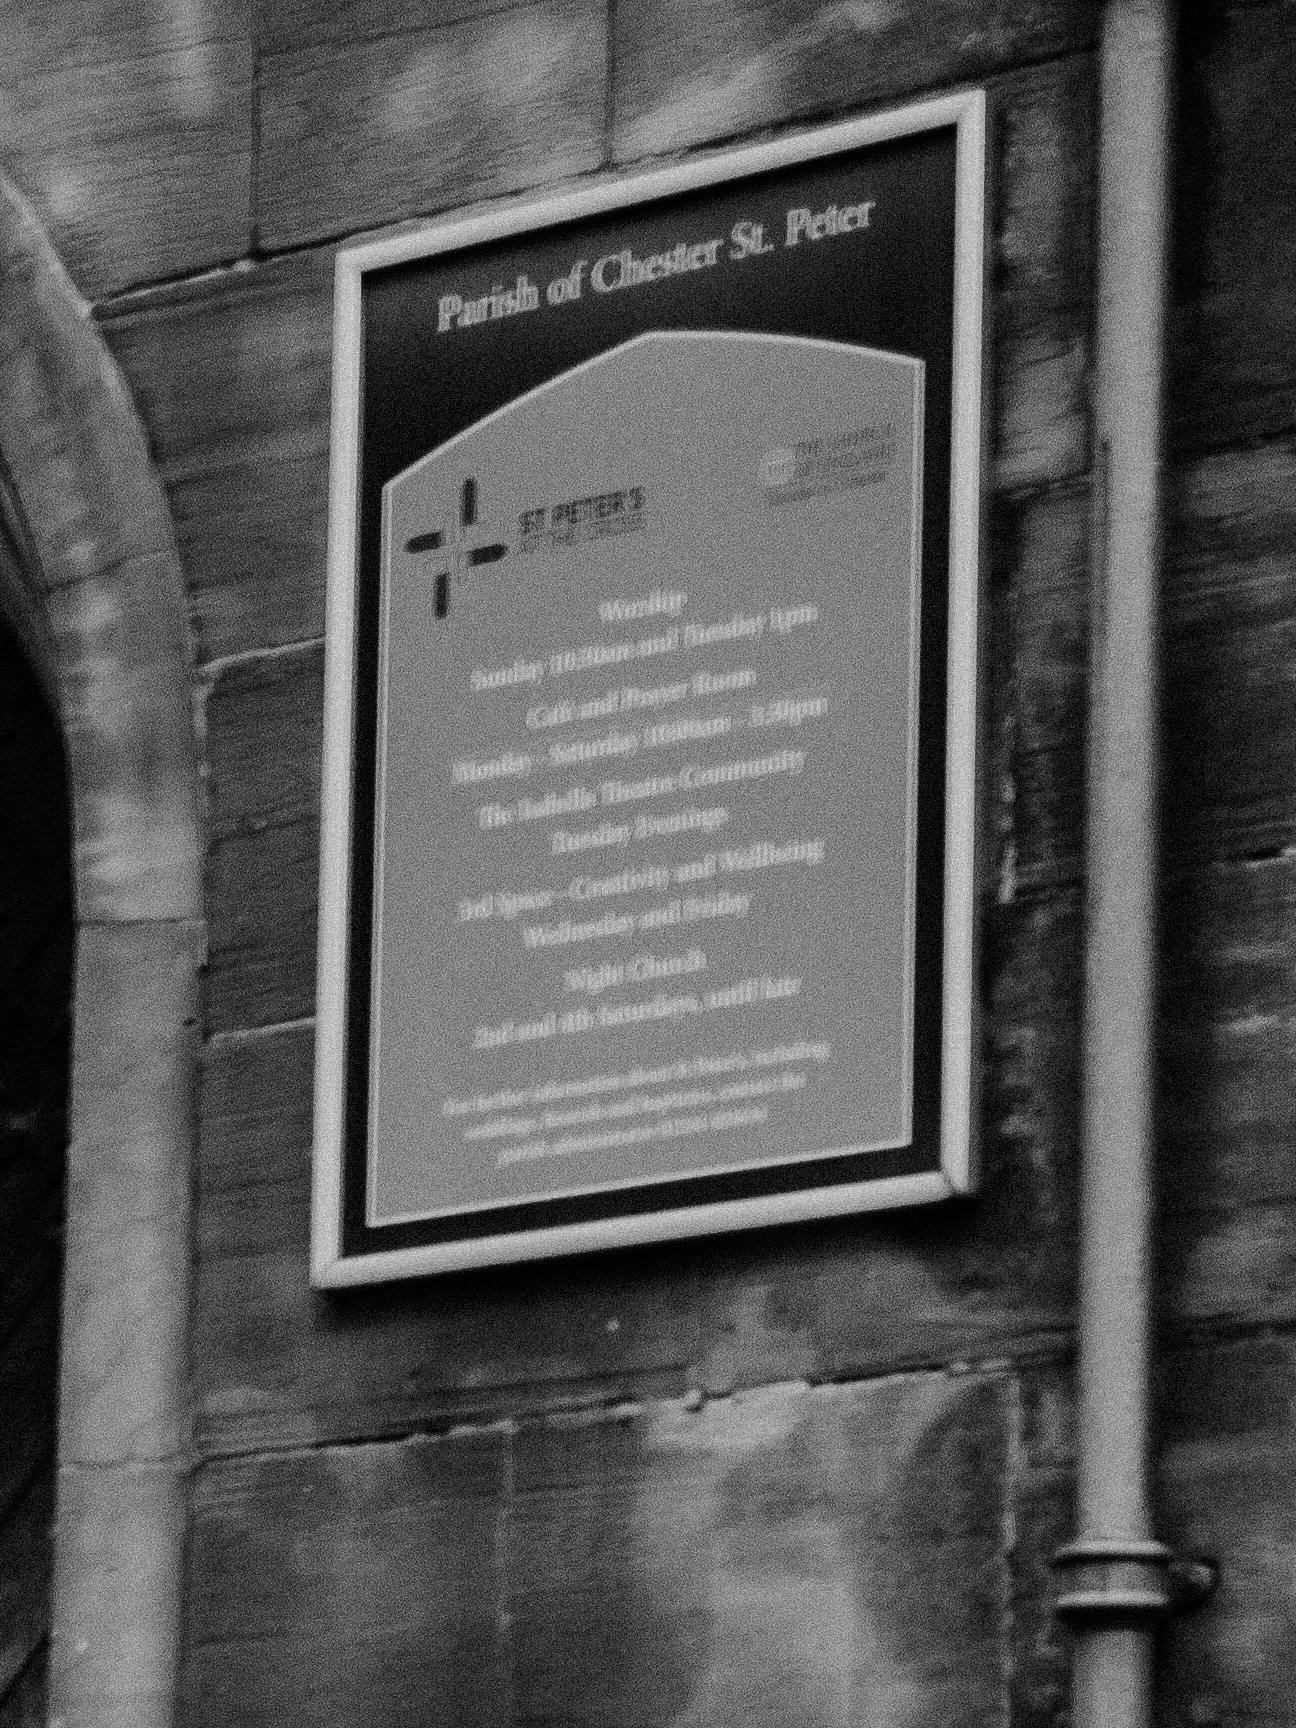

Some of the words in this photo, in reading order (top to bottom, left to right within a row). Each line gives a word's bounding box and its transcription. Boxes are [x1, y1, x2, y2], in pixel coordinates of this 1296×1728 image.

[436, 275, 538, 331] Parish
[547, 259, 588, 303] of
[589, 237, 724, 291] Chester
[728, 219, 775, 260] St.
[784, 198, 876, 247] Peter
[470, 657, 543, 692] Sunday
[639, 626, 679, 658] and
[685, 613, 764, 649] Tuesday
[577, 690, 618, 720] and
[693, 667, 757, 697] Room
[453, 749, 532, 785] Monday
[550, 727, 637, 767] Saturday
[675, 853, 715, 884] and
[523, 911, 634, 949] Wednesday
[640, 899, 680, 930] and
[628, 947, 707, 982] Church
[517, 1012, 556, 1042] and
